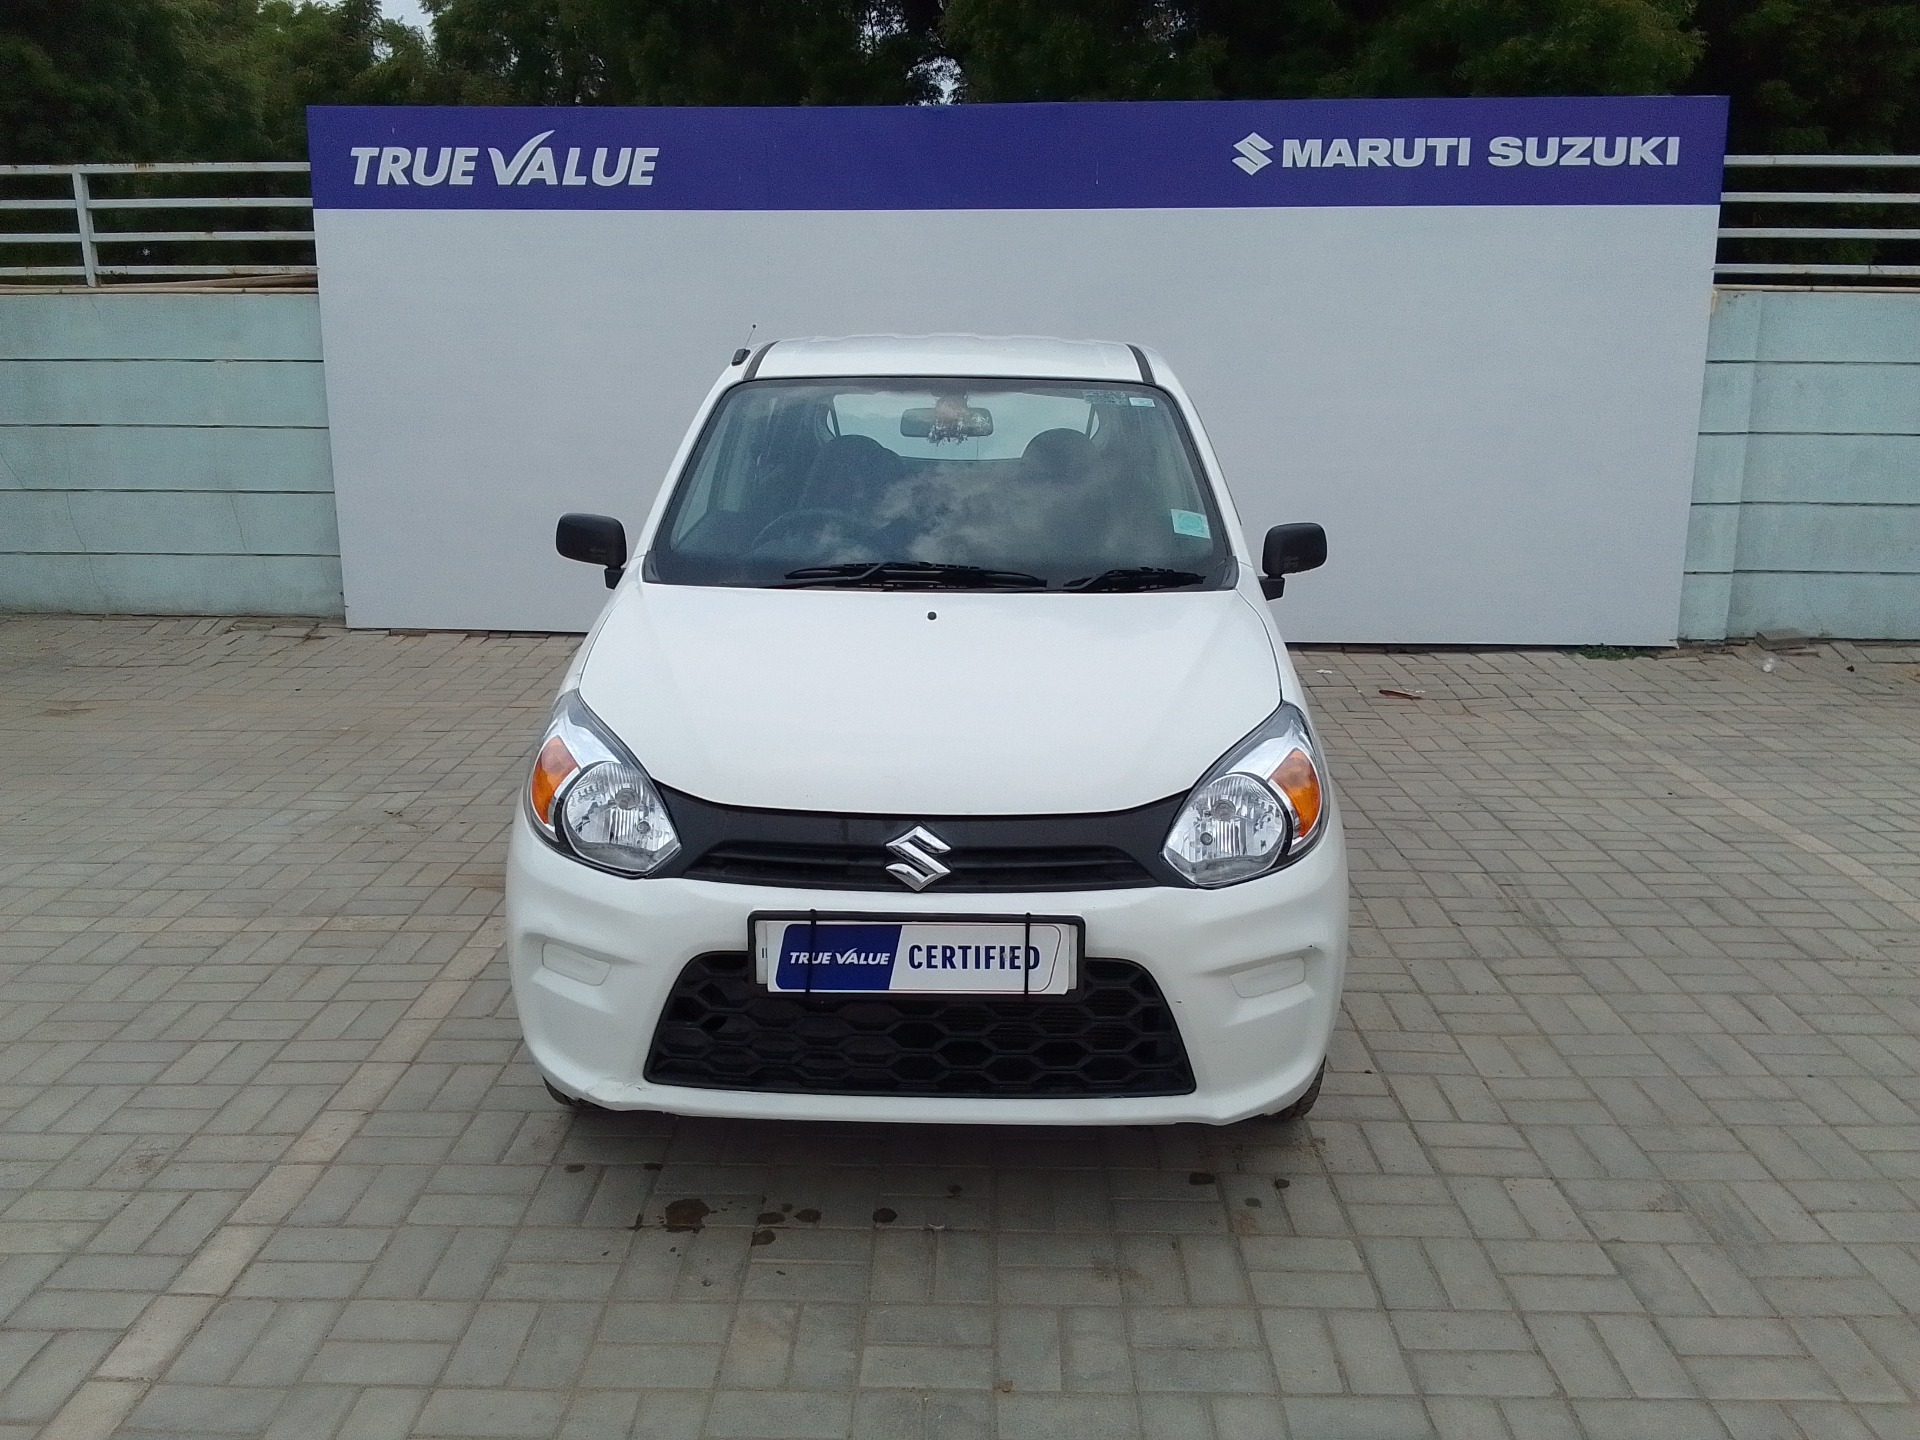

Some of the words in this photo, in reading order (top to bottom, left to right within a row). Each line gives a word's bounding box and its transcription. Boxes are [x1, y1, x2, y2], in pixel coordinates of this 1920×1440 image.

[350, 147, 479, 186] TRUE
[488, 129, 660, 186] VALUE
[1281, 137, 1471, 168] MARUTI
[1488, 135, 1680, 167] SUZUKI
[789, 951, 832, 965] TRUE
[834, 947, 891, 966] VALUE
[908, 944, 1041, 970] CERTIFIED
